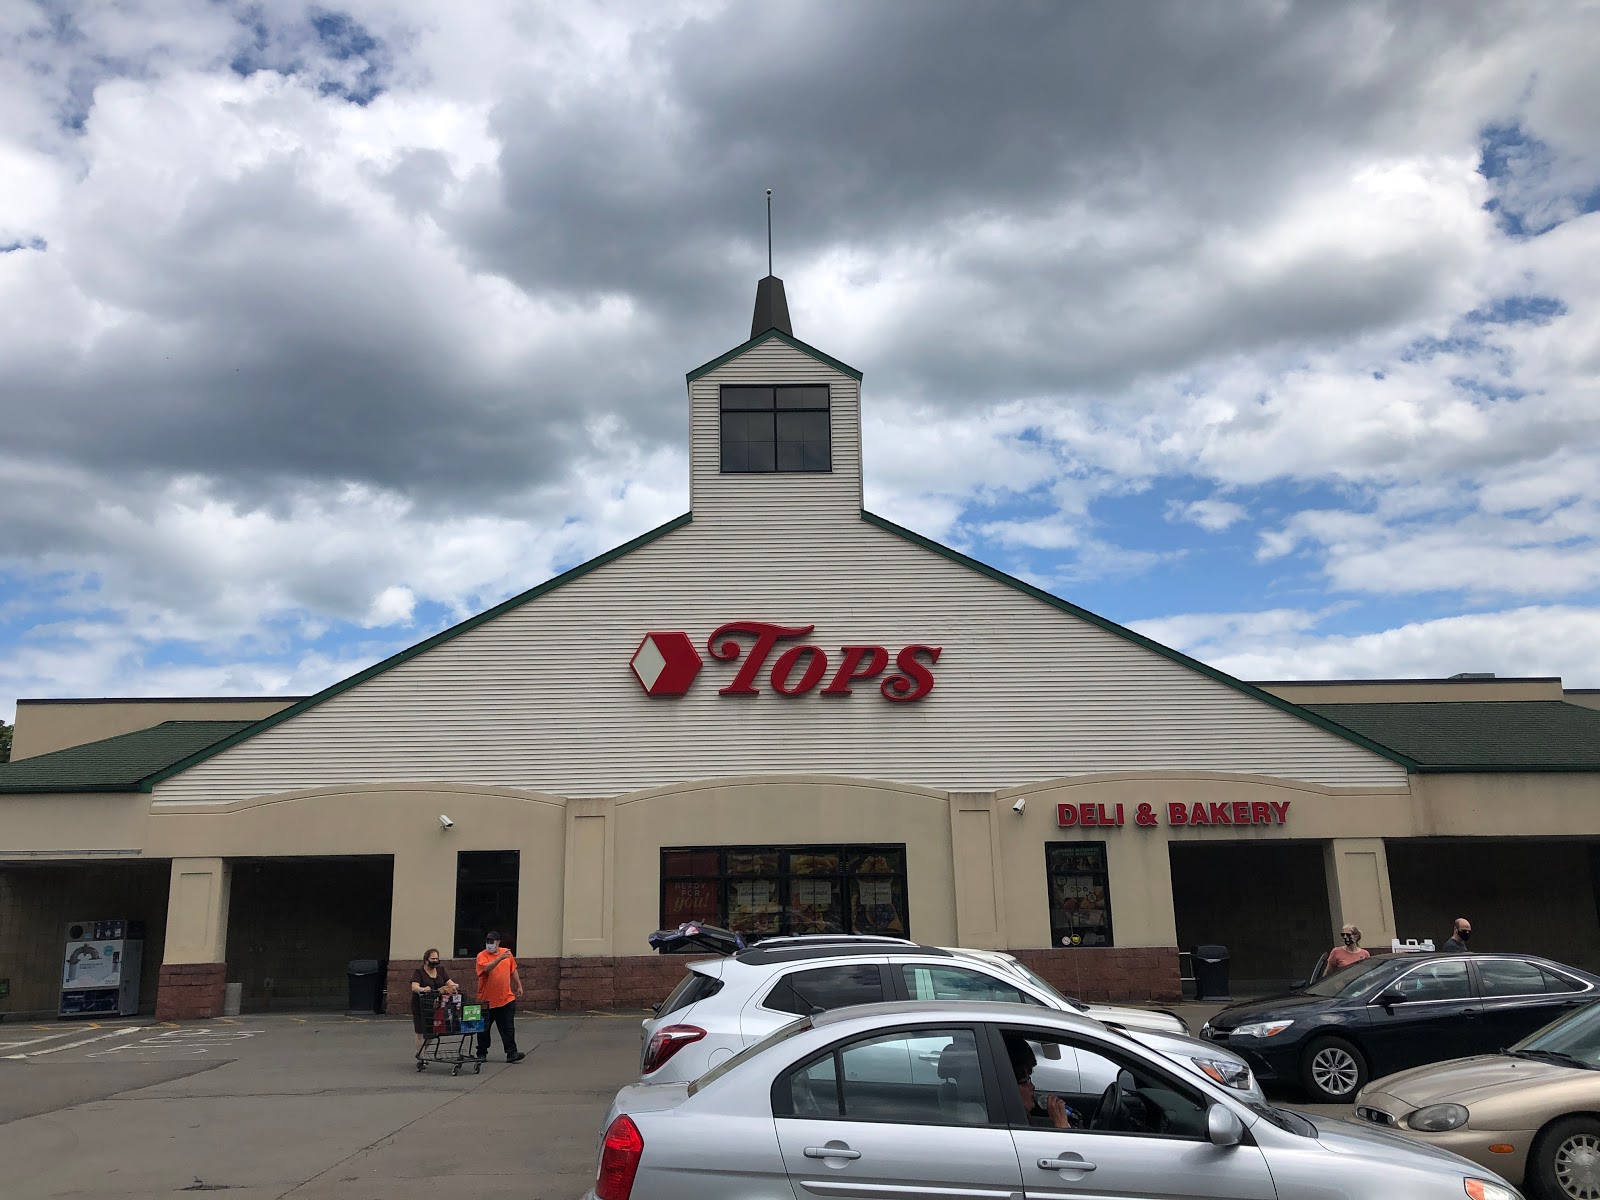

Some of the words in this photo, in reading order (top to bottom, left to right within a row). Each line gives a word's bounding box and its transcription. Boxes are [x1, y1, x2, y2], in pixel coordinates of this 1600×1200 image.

[1057, 802, 1125, 827] DELI
[1135, 802, 1159, 827] &
[1167, 801, 1291, 826] BAKERY
